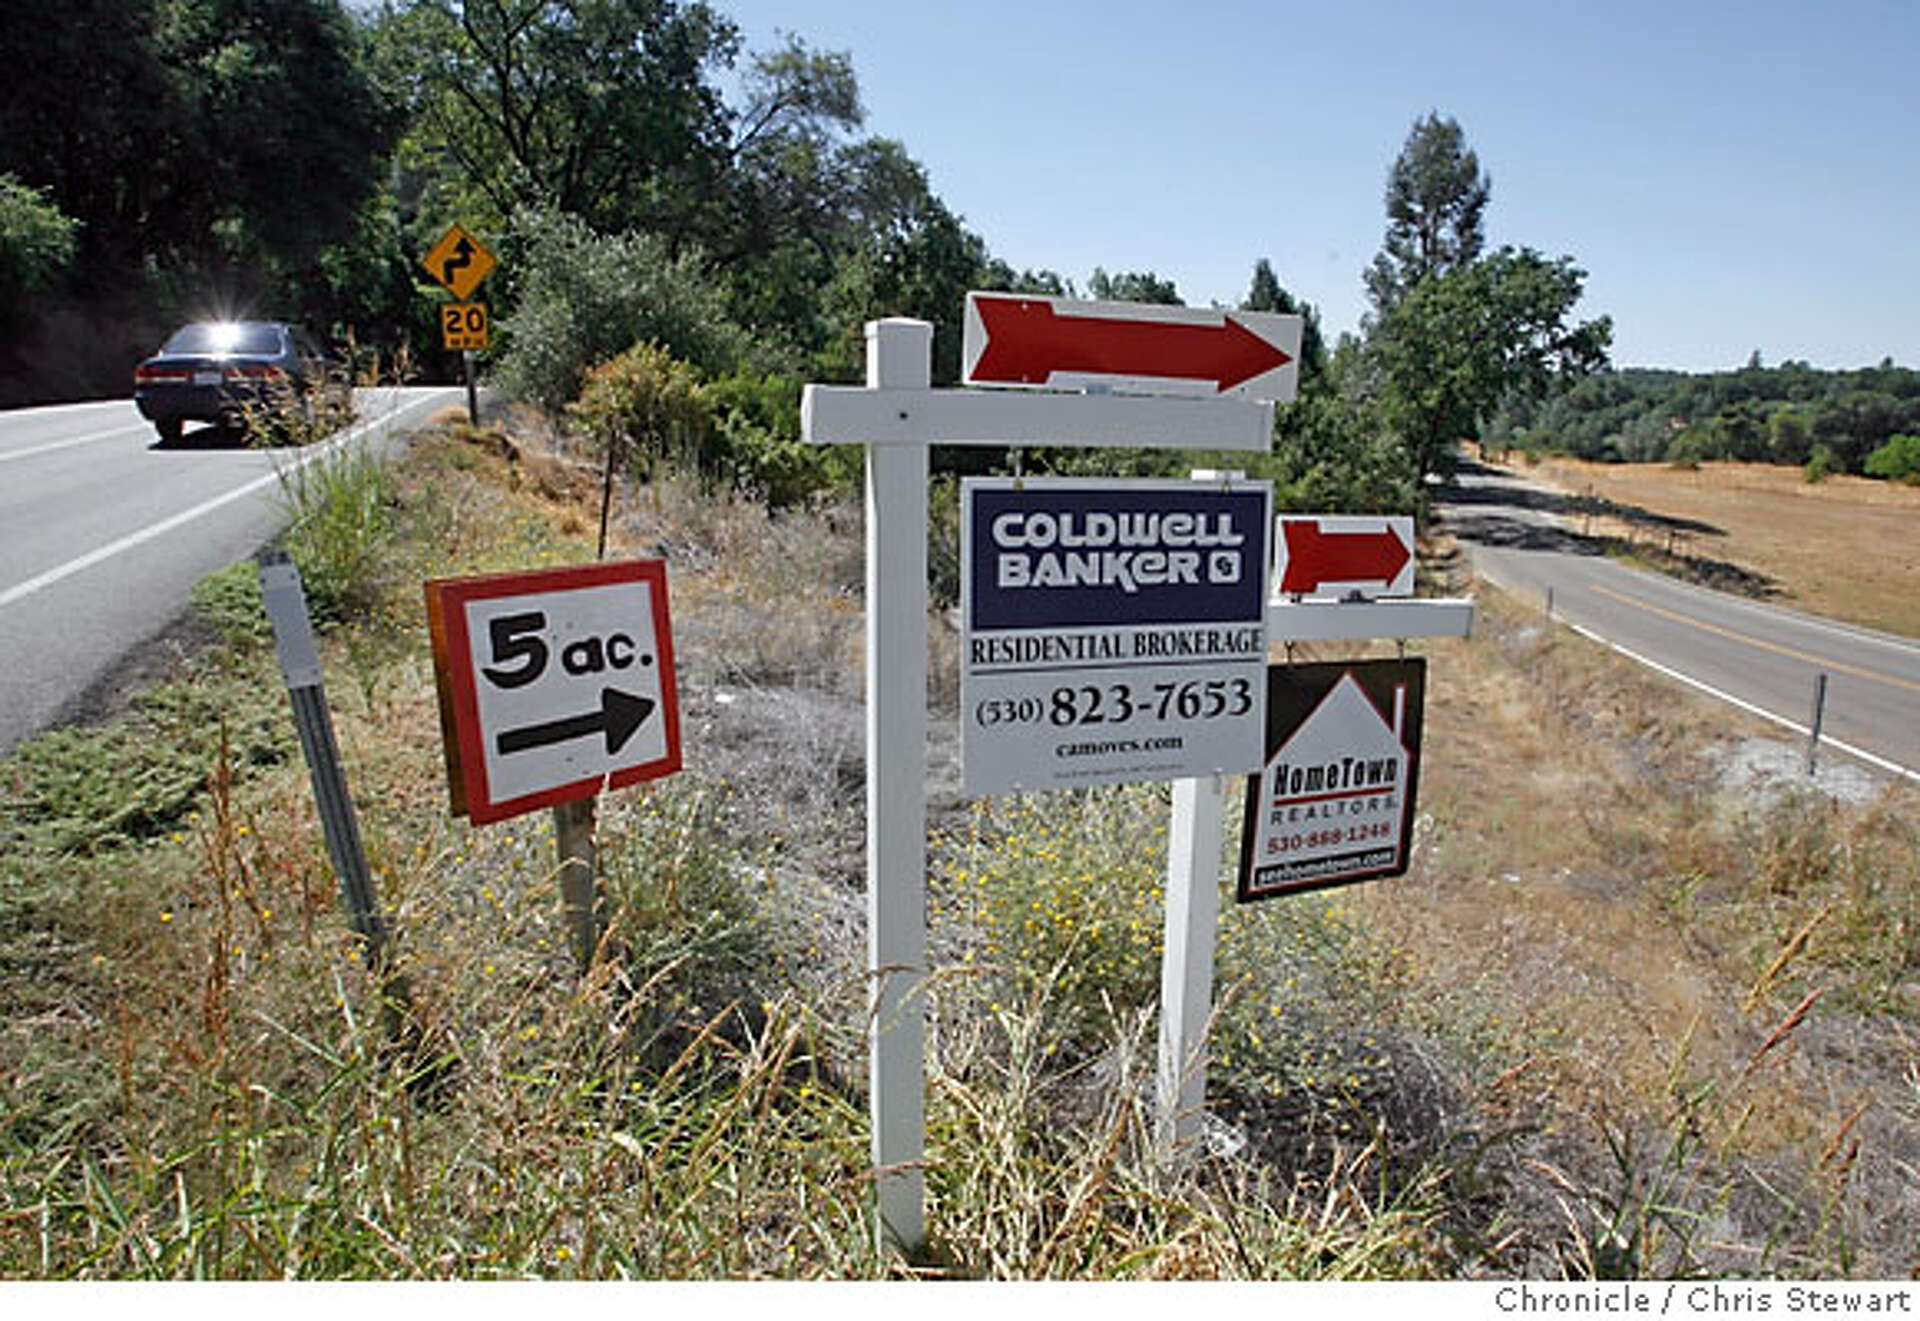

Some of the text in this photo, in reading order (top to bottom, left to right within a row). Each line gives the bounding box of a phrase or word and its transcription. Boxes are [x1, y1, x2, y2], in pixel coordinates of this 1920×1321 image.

[446, 308, 485, 333] 20
[481, 612, 653, 689] 5 ac.
[970, 628, 1263, 664] RESIDENTIAL BROKERAGE
[976, 679, 1253, 727] (530) 823-7653
[1056, 736, 1183, 758] camoves.com
[1273, 757, 1398, 796] HomeTown
